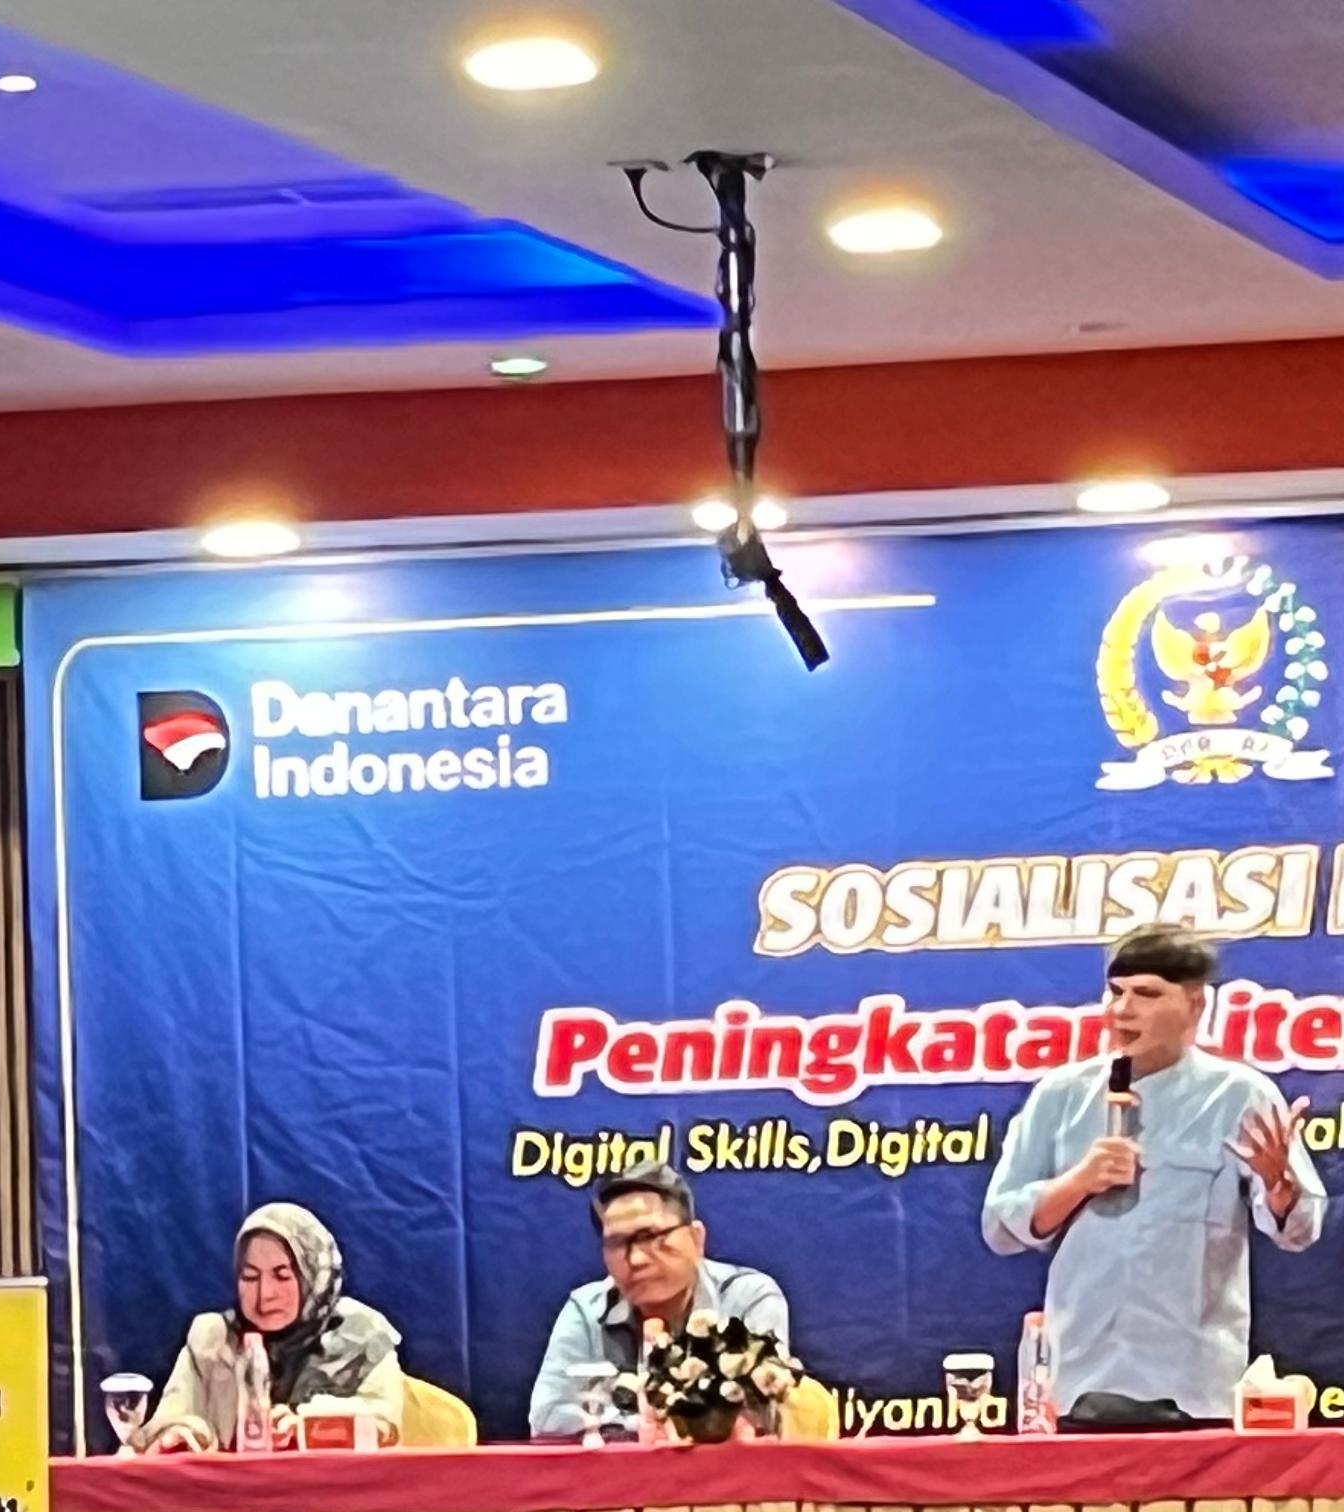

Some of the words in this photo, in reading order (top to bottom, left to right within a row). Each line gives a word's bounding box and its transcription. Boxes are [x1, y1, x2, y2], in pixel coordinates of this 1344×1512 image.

[255, 735, 548, 798] Indonesia
[758, 847, 1315, 949] SOSIALISASI
[512, 1124, 672, 1187] Digital
